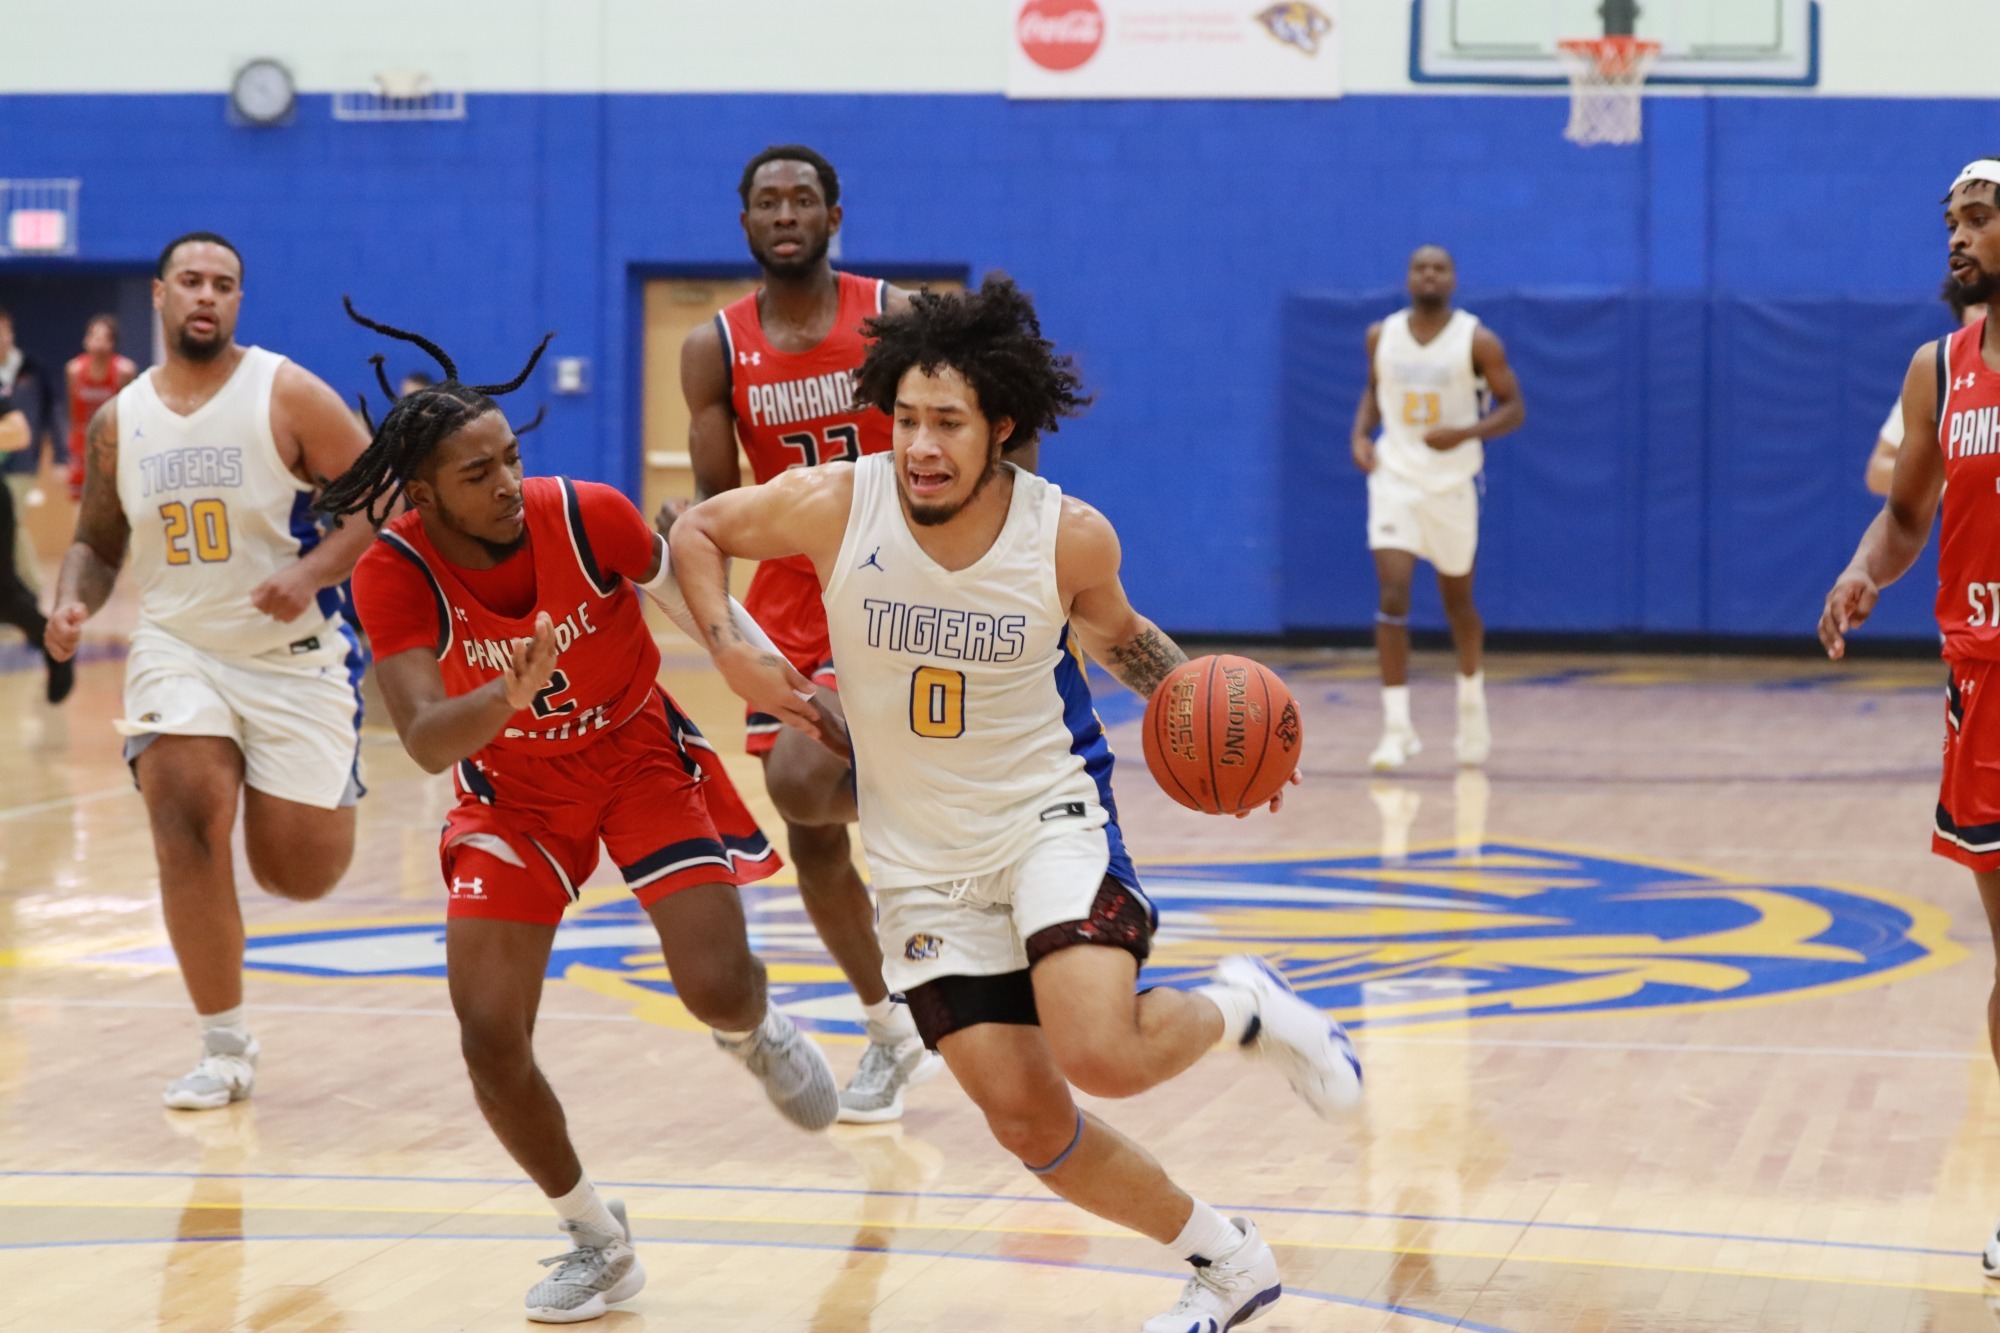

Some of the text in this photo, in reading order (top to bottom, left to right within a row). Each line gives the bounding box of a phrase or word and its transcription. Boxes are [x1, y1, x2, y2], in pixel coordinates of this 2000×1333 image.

[748, 368, 873, 426] PANHAND
[140, 447, 242, 497] TIGERS
[159, 498, 232, 565] 20
[864, 598, 1026, 662] TIGERS
[1968, 581, 2000, 628] ST
[529, 668, 578, 720] 2
[909, 665, 966, 738] 0
[1178, 672, 1201, 762] LEGACY
[1221, 666, 1247, 768] SPALDING
